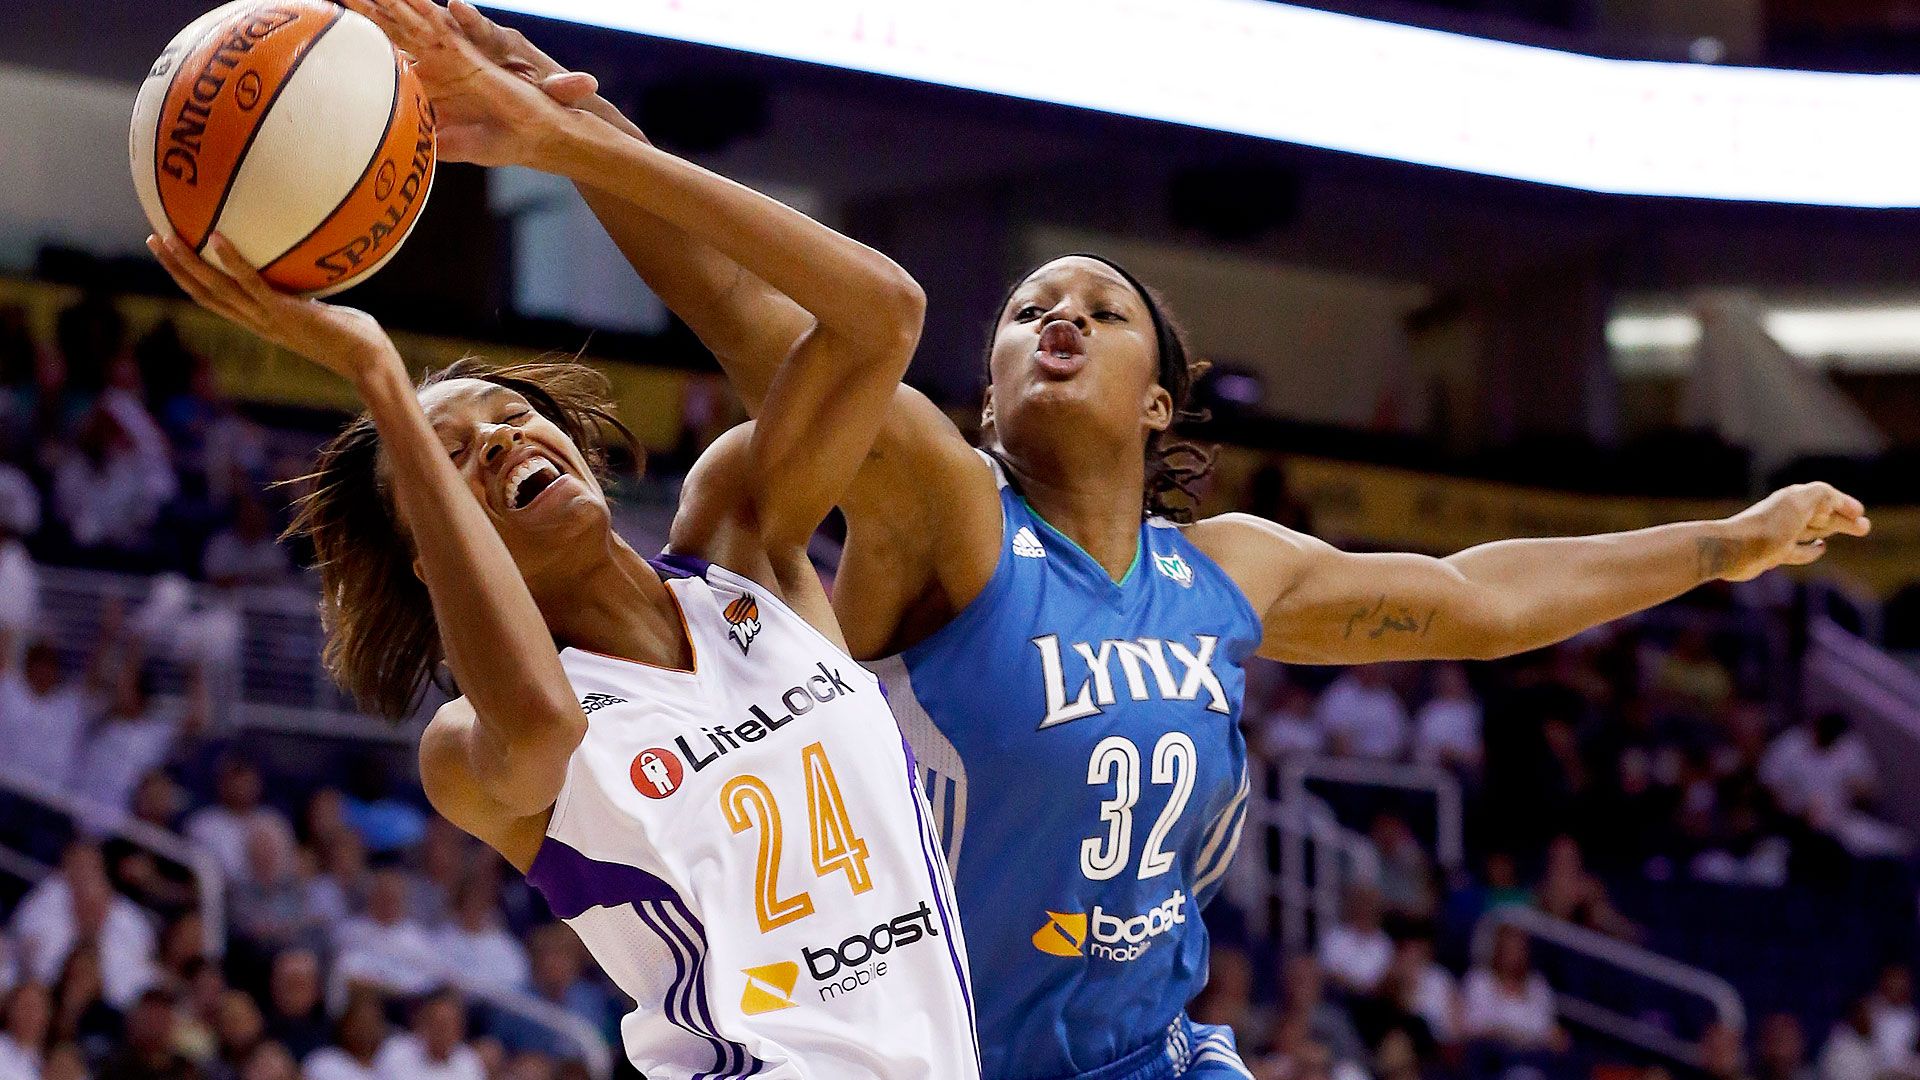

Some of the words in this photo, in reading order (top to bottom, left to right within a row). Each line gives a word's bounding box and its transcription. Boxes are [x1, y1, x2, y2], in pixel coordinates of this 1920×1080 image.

[315, 92, 437, 281] SPALDING
[675, 662, 855, 772] LifeLock
[1032, 633, 1230, 731] LYNX
[719, 741, 873, 934] 24
[1080, 731, 1197, 881] 32
[801, 901, 938, 981] boost
[1091, 940, 1151, 962] mob
[1092, 889, 1186, 943] boost
[819, 962, 888, 1001] mobile
